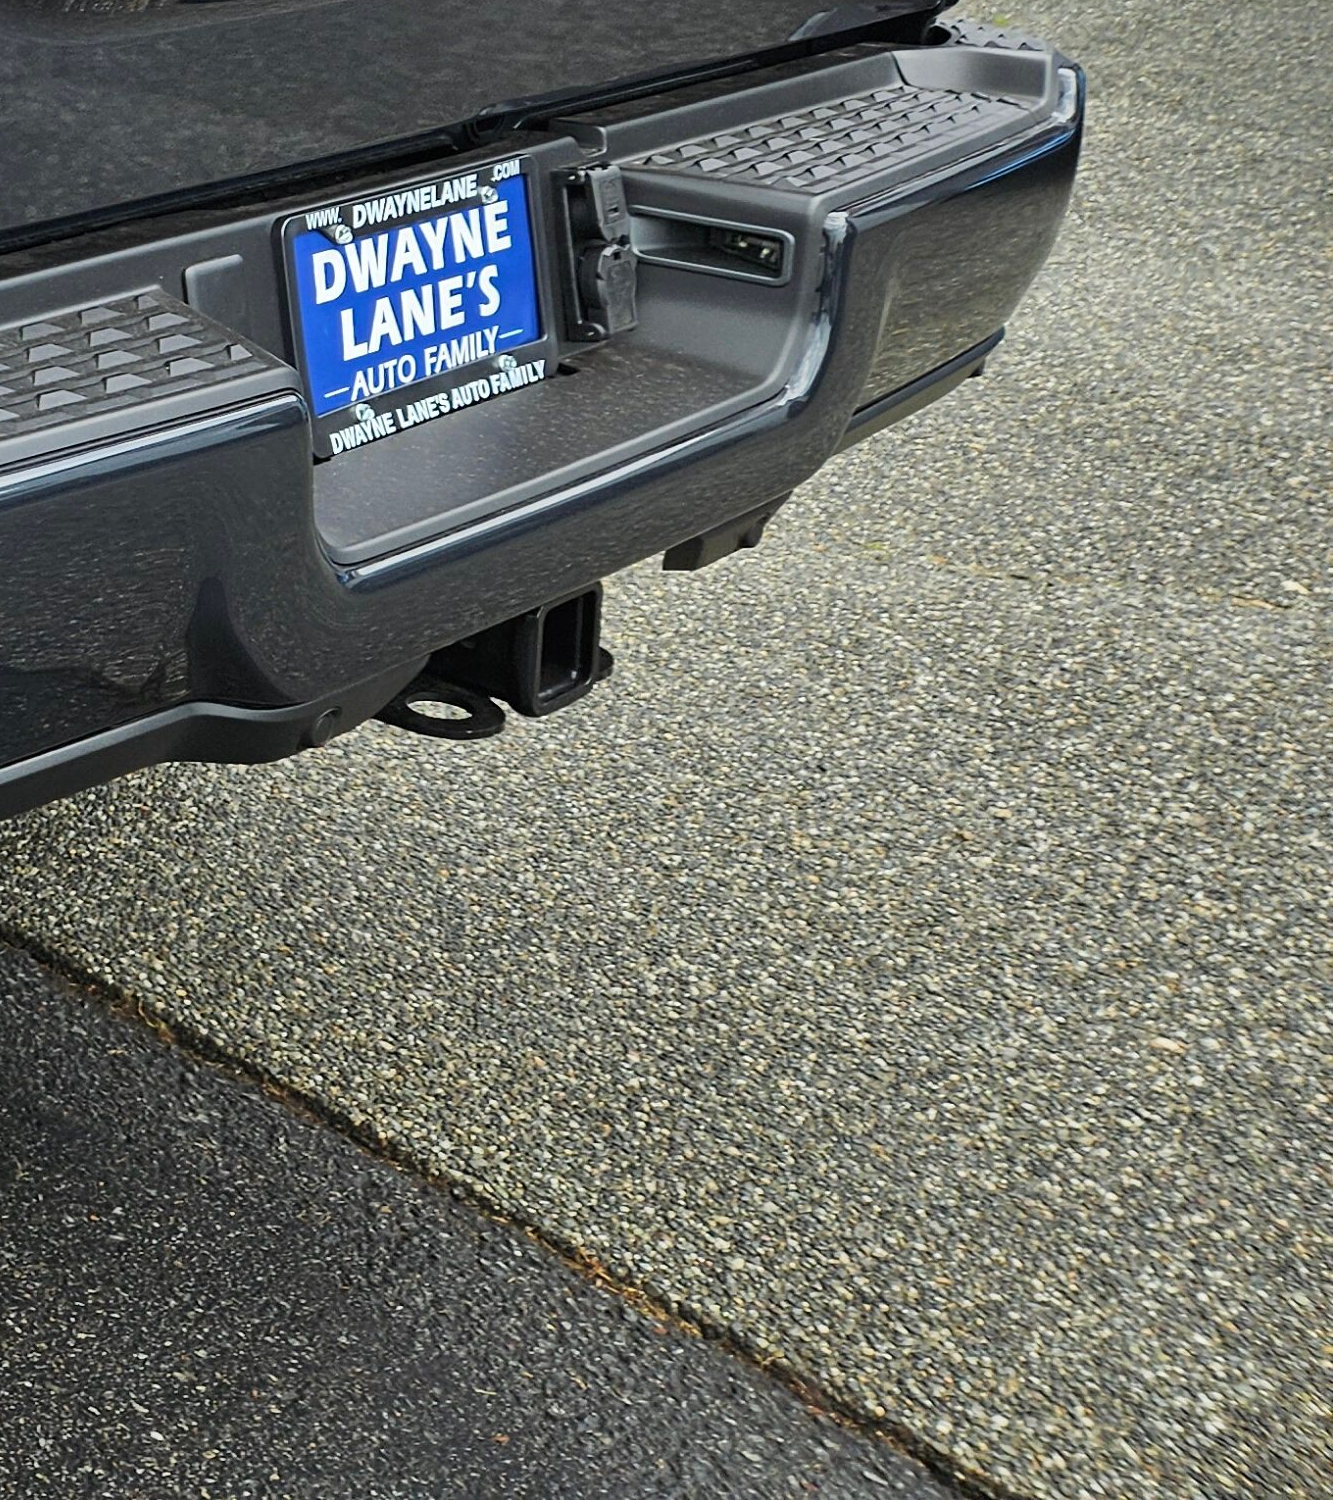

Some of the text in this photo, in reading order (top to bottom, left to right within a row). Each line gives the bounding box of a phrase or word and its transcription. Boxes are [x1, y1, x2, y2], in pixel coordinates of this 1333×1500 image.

[352, 174, 478, 229] DWAYNELANE
[311, 200, 513, 305] DWAYNE
[339, 264, 502, 362] LANE'S
[329, 359, 547, 455] DWAYNE LANE'S AUTO FAMILY
[350, 325, 501, 401] AUTO FAMILY
